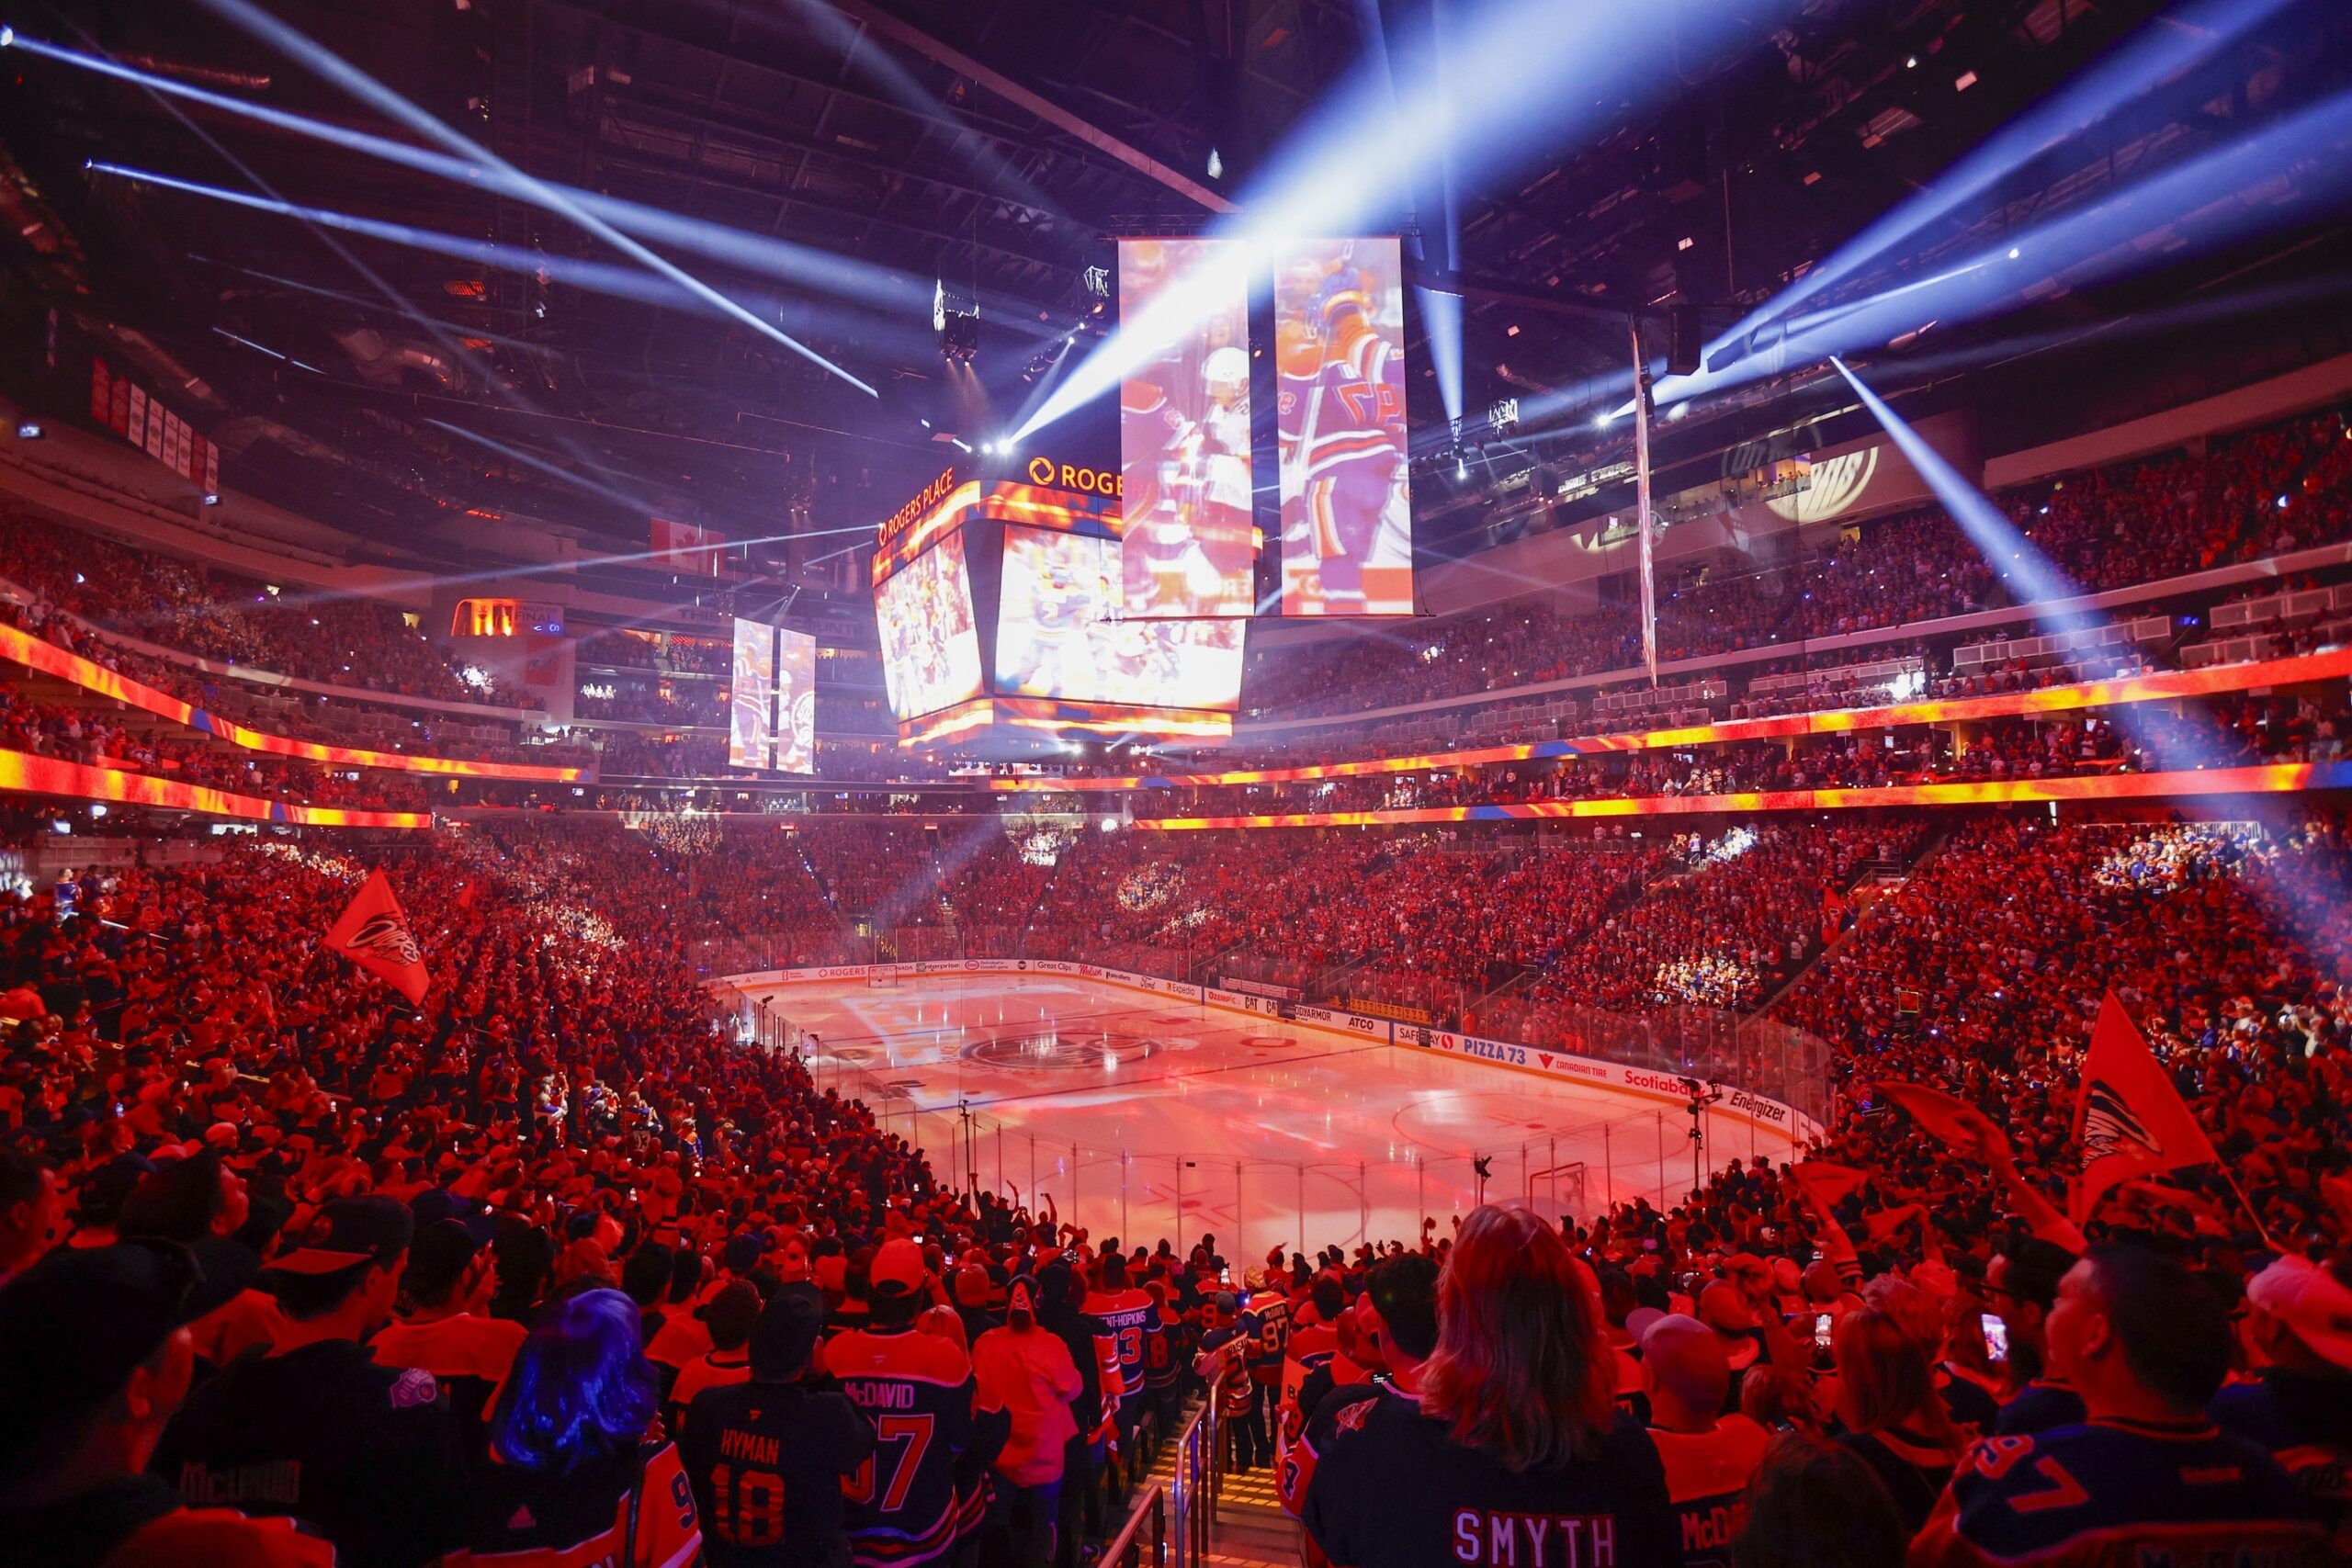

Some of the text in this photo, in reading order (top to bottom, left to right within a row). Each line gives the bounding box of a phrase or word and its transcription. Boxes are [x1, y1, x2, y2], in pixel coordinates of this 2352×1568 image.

[1061, 464, 1122, 497] ROGE
[888, 467, 953, 539] ROGERS PLACE
[515, 611, 551, 623] FINAL
[830, 967, 865, 976] ROGERS
[1037, 961, 1072, 972] Great Clips
[1140, 976, 1156, 990] Ford
[1172, 983, 1195, 996] Expedia
[1245, 997, 1258, 1010] CAT
[1295, 1006, 1331, 1021] ODYARMOR
[1349, 1017, 1374, 1030] ATCO
[1399, 1027, 1440, 1045] SAFEAY
[1464, 1038, 1526, 1065] PIZZA 73
[1556, 1060, 1607, 1078] CANADIAN TIRE
[1730, 1091, 1786, 1122] Energizer
[1100, 1310, 1147, 1328] NT-HOPKINS
[1262, 1317, 1289, 1354] 97
[844, 1381, 914, 1408] McDAVID
[720, 1427, 780, 1465] HYMAN
[710, 1462, 786, 1548] 18
[1452, 1507, 1616, 1568] SMYTH
